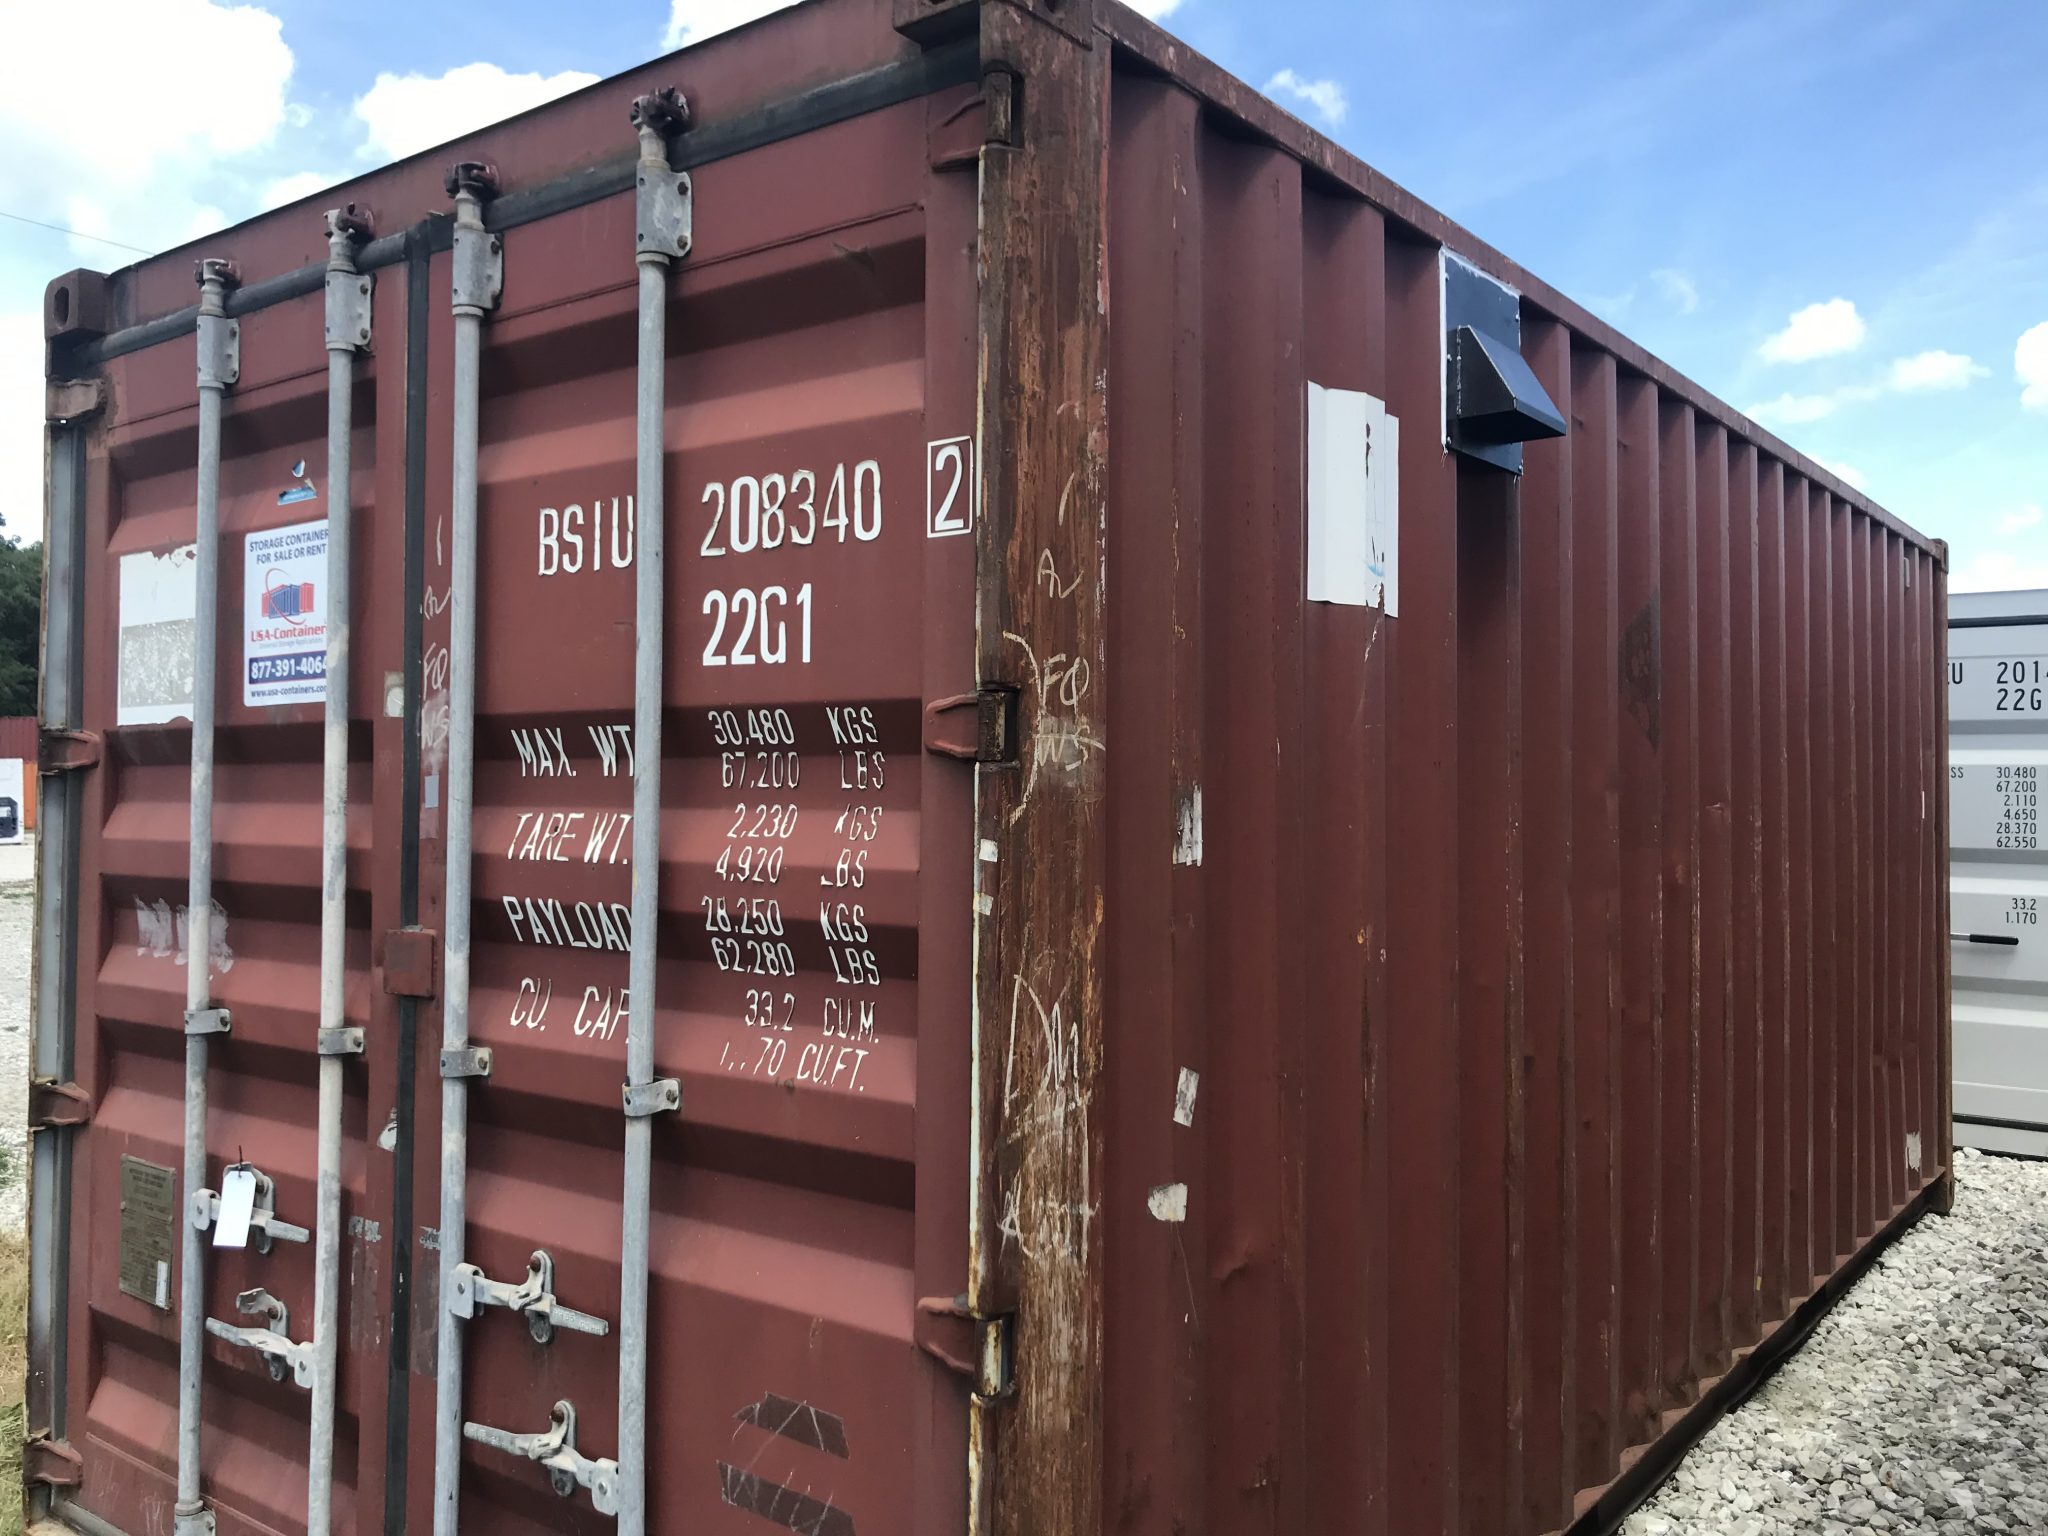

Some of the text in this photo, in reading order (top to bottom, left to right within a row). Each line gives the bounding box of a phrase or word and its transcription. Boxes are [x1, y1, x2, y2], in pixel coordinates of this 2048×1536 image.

[538, 445, 965, 576] BSIU 208340 2
[249, 537, 284, 552] STORAGE
[256, 543, 327, 565] FOR SALE OR RENT
[702, 582, 813, 666] 22G1
[1946, 660, 2048, 685] U 201
[1996, 688, 2042, 711] 22G
[510, 727, 577, 777] MAX.
[825, 706, 879, 745] KGS
[839, 750, 886, 790] LBS
[1996, 766, 2037, 779] 30.480
[1996, 780, 2037, 793] 67.200
[2003, 794, 2037, 807] 2.110
[2003, 808, 2037, 821] 4.650
[507, 812, 585, 862] TARE
[583, 812, 634, 865] WT.
[1996, 821, 2037, 835] 28.370
[1996, 835, 2037, 849] 62.550
[2011, 897, 2037, 911] 33.2
[502, 895, 632, 952] PAYLOAD
[820, 901, 869, 943] KGS
[2005, 911, 2037, 925] 1.170
[828, 945, 881, 986] LBS
[510, 977, 552, 1032] CU.
[745, 988, 796, 1032] 33.2
[823, 997, 880, 1045] CU.M.
[796, 1042, 870, 1092] CU.FT.
